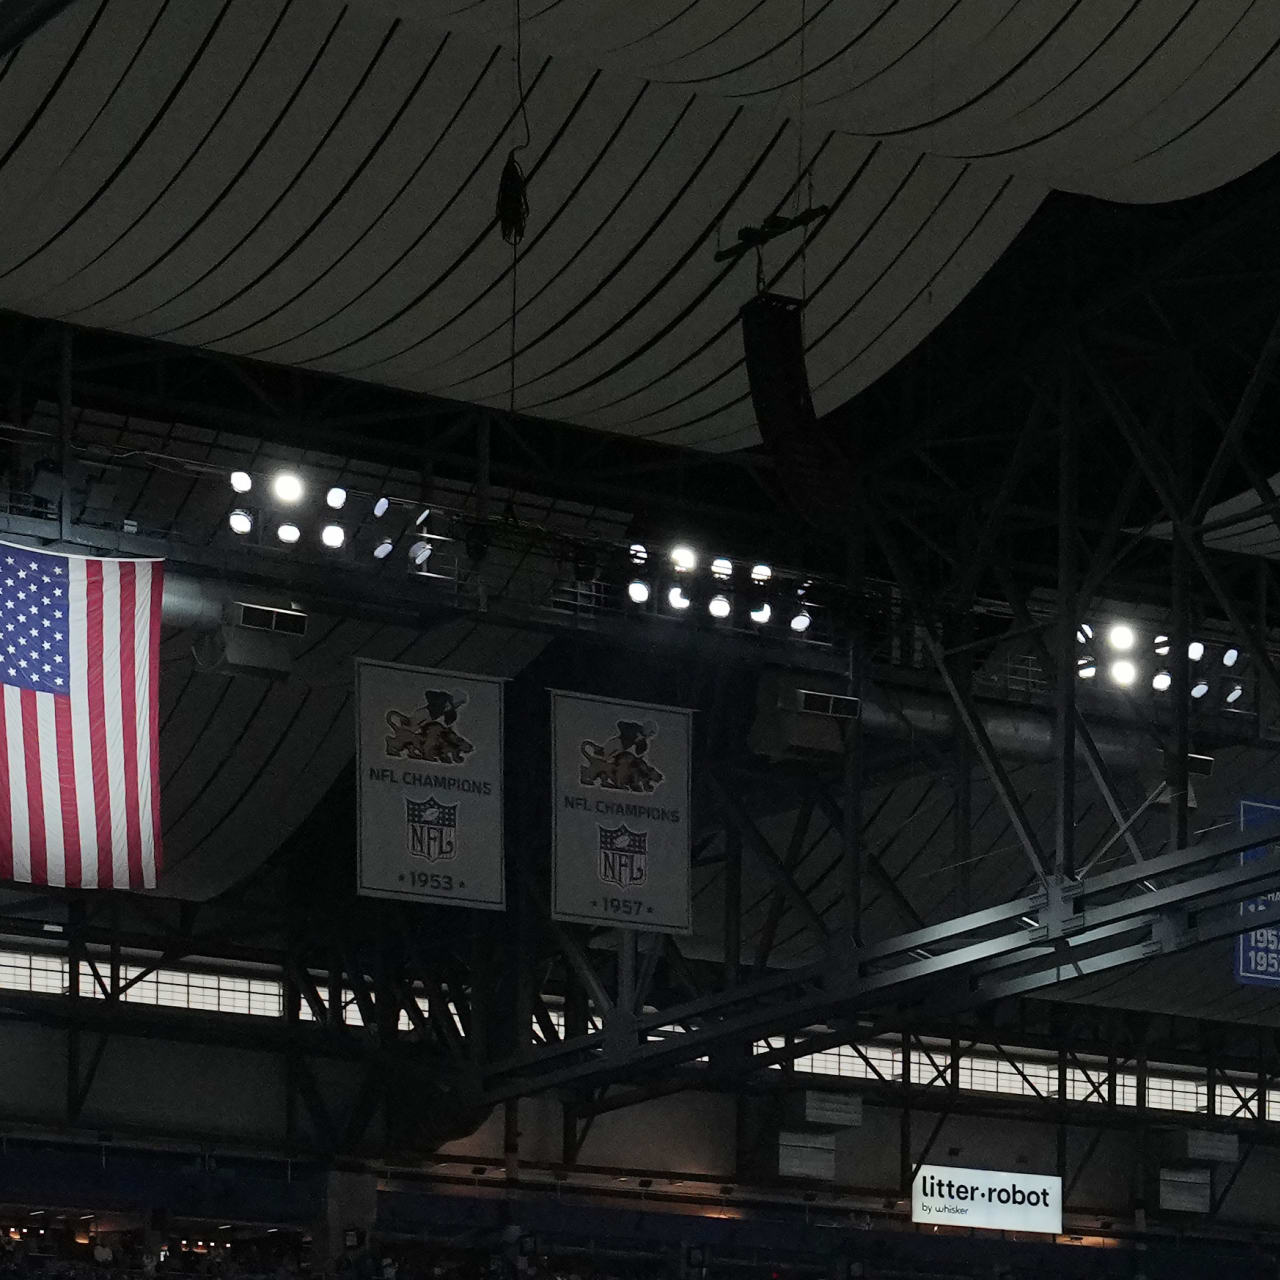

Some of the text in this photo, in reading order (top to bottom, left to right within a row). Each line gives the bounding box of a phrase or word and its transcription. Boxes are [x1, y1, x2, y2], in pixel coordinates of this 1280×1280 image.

[369, 767, 493, 796] NFL CHAMPIONS
[563, 796, 681, 824] NFL CHAMPIONS
[411, 823, 455, 856] NFL
[602, 850, 647, 883] NFL
[410, 870, 455, 892] 1953
[602, 898, 643, 917] 1957
[921, 1202, 969, 1215] by whisker
